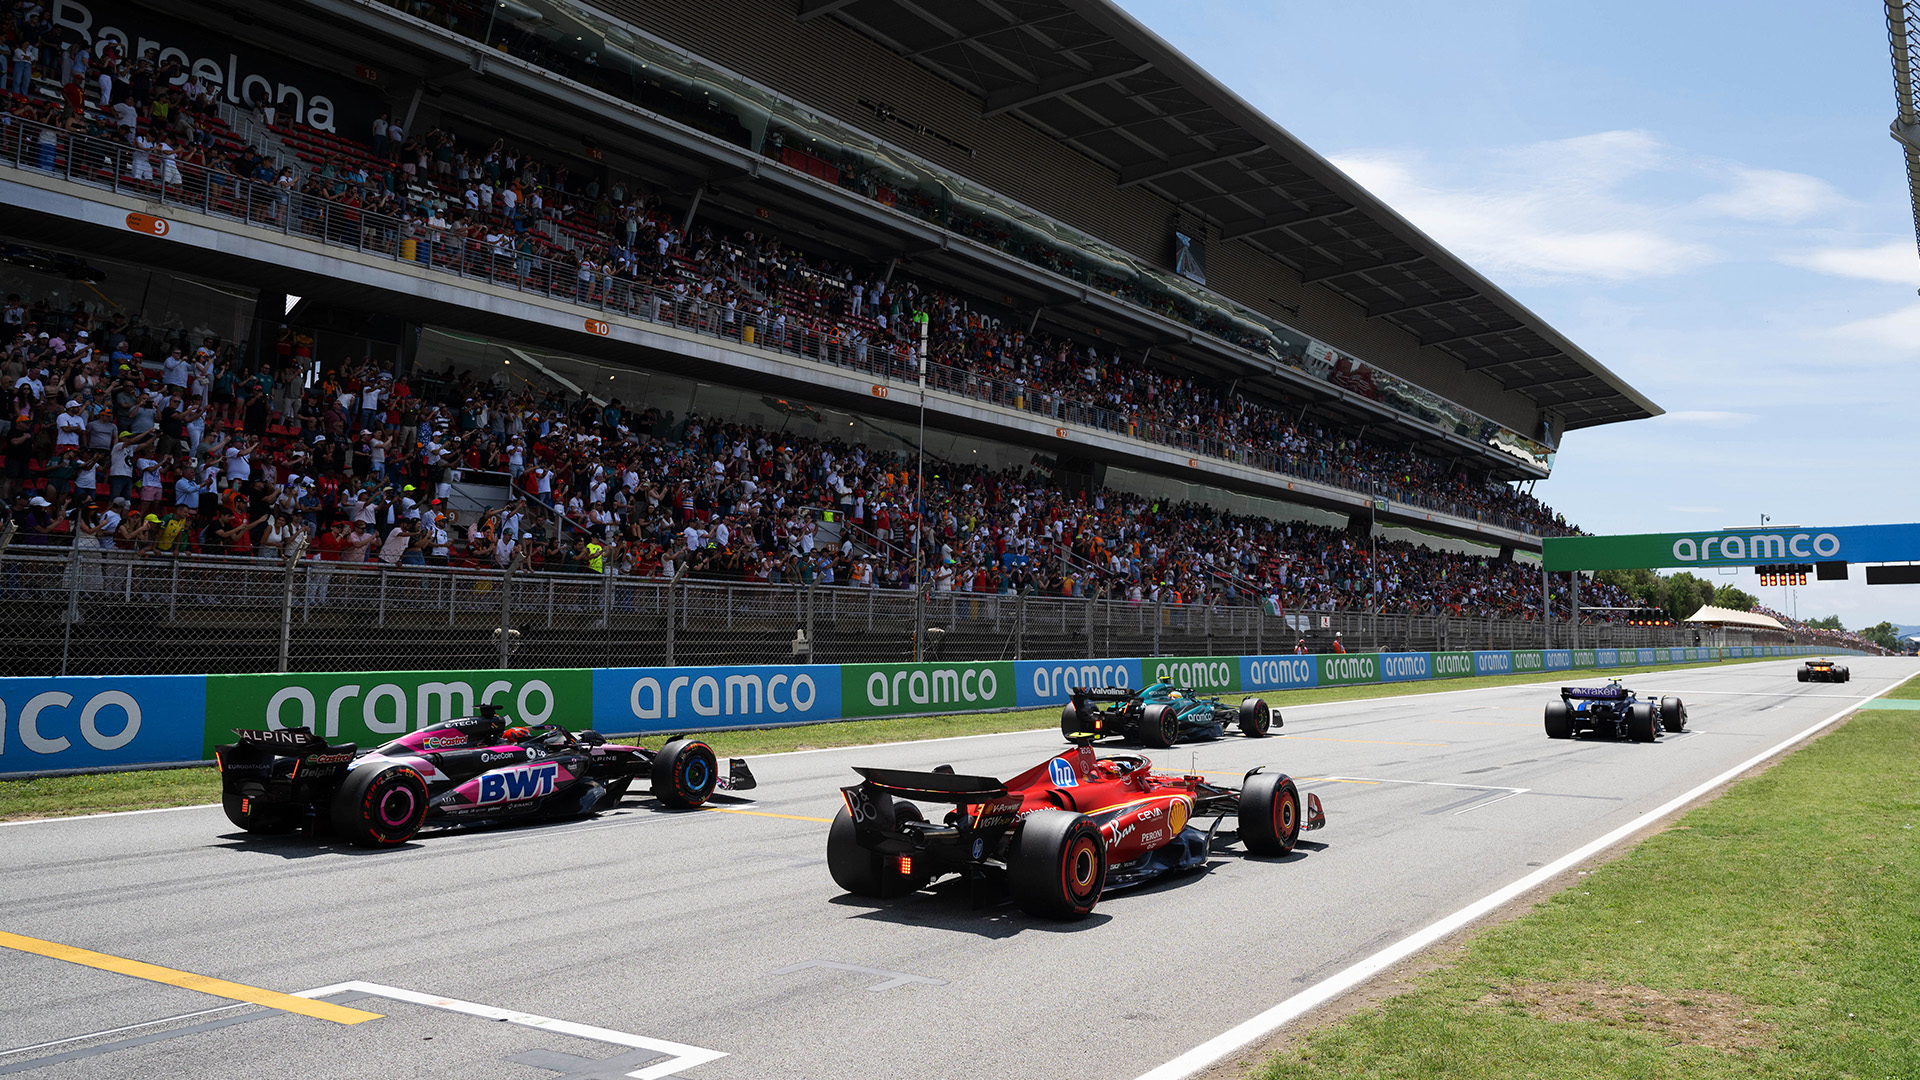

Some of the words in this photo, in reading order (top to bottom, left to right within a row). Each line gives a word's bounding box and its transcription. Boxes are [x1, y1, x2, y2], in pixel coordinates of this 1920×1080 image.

[51, 0, 336, 134] Barcelona
[365, 69, 377, 80] 13
[154, 220, 166, 235] 9
[594, 322, 608, 335] 10
[878, 387, 887, 397] 11
[448, 512, 456, 522] 9
[1672, 533, 1840, 562] aramco
[1386, 657, 1425, 676] aramco
[1436, 656, 1471, 674] aramco
[1479, 655, 1508, 672] aramco
[1515, 654, 1542, 670] aramco
[1547, 653, 1570, 668] aramco
[1156, 662, 1230, 688] aramco
[1251, 660, 1310, 684] aramco
[1326, 658, 1374, 680] aramco
[866, 669, 998, 706] aramco
[1032, 664, 1129, 697] aramco
[630, 674, 816, 719] aramco
[1091, 687, 1125, 696] Valvoline
[1582, 688, 1617, 697] kraken
[266, 680, 555, 737] aramco
[0, 691, 142, 756] co
[1187, 712, 1212, 722] aramco
[242, 730, 307, 744] ALPINE
[440, 735, 468, 747] Castrol
[317, 752, 353, 763] Castrol
[489, 752, 514, 761] ApeCoin
[300, 766, 336, 778] Delphi
[1053, 759, 1073, 786] hp
[479, 765, 557, 803] BWT
[993, 803, 1020, 813] V-Power
[1141, 829, 1163, 843] PERONI
